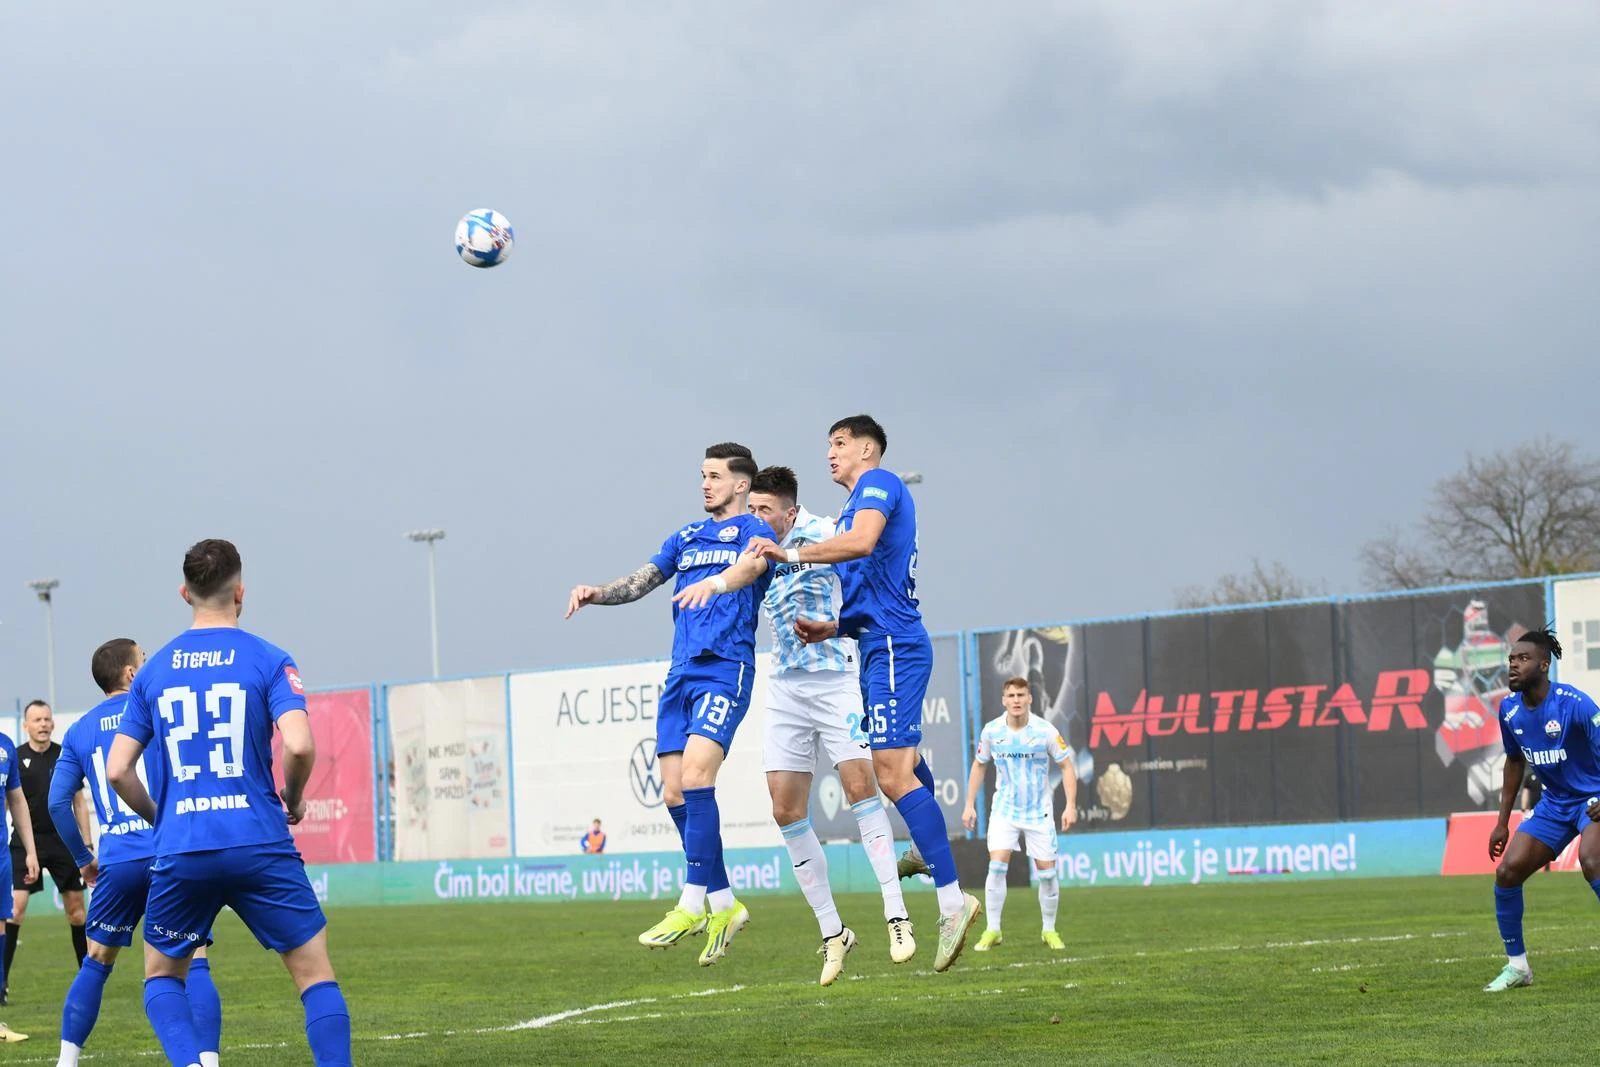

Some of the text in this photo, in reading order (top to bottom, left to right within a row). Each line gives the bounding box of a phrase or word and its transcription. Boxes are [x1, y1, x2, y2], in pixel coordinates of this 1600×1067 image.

[775, 561, 812, 578] AVBET
[556, 688, 589, 727] AC
[697, 691, 730, 726] 13
[1089, 669, 1429, 749] MULTISTAR
[158, 683, 247, 783] 23
[1533, 749, 1568, 765] BELUPO
[176, 795, 250, 815] RADNIK
[1057, 833, 1357, 886] ne, uvijek je uz mene!
[434, 861, 473, 898] Čim
[474, 864, 508, 897] bol
[513, 863, 577, 900] krene,
[583, 862, 648, 902] uvijek
[650, 861, 673, 899] je
[724, 857, 781, 889] ene!
